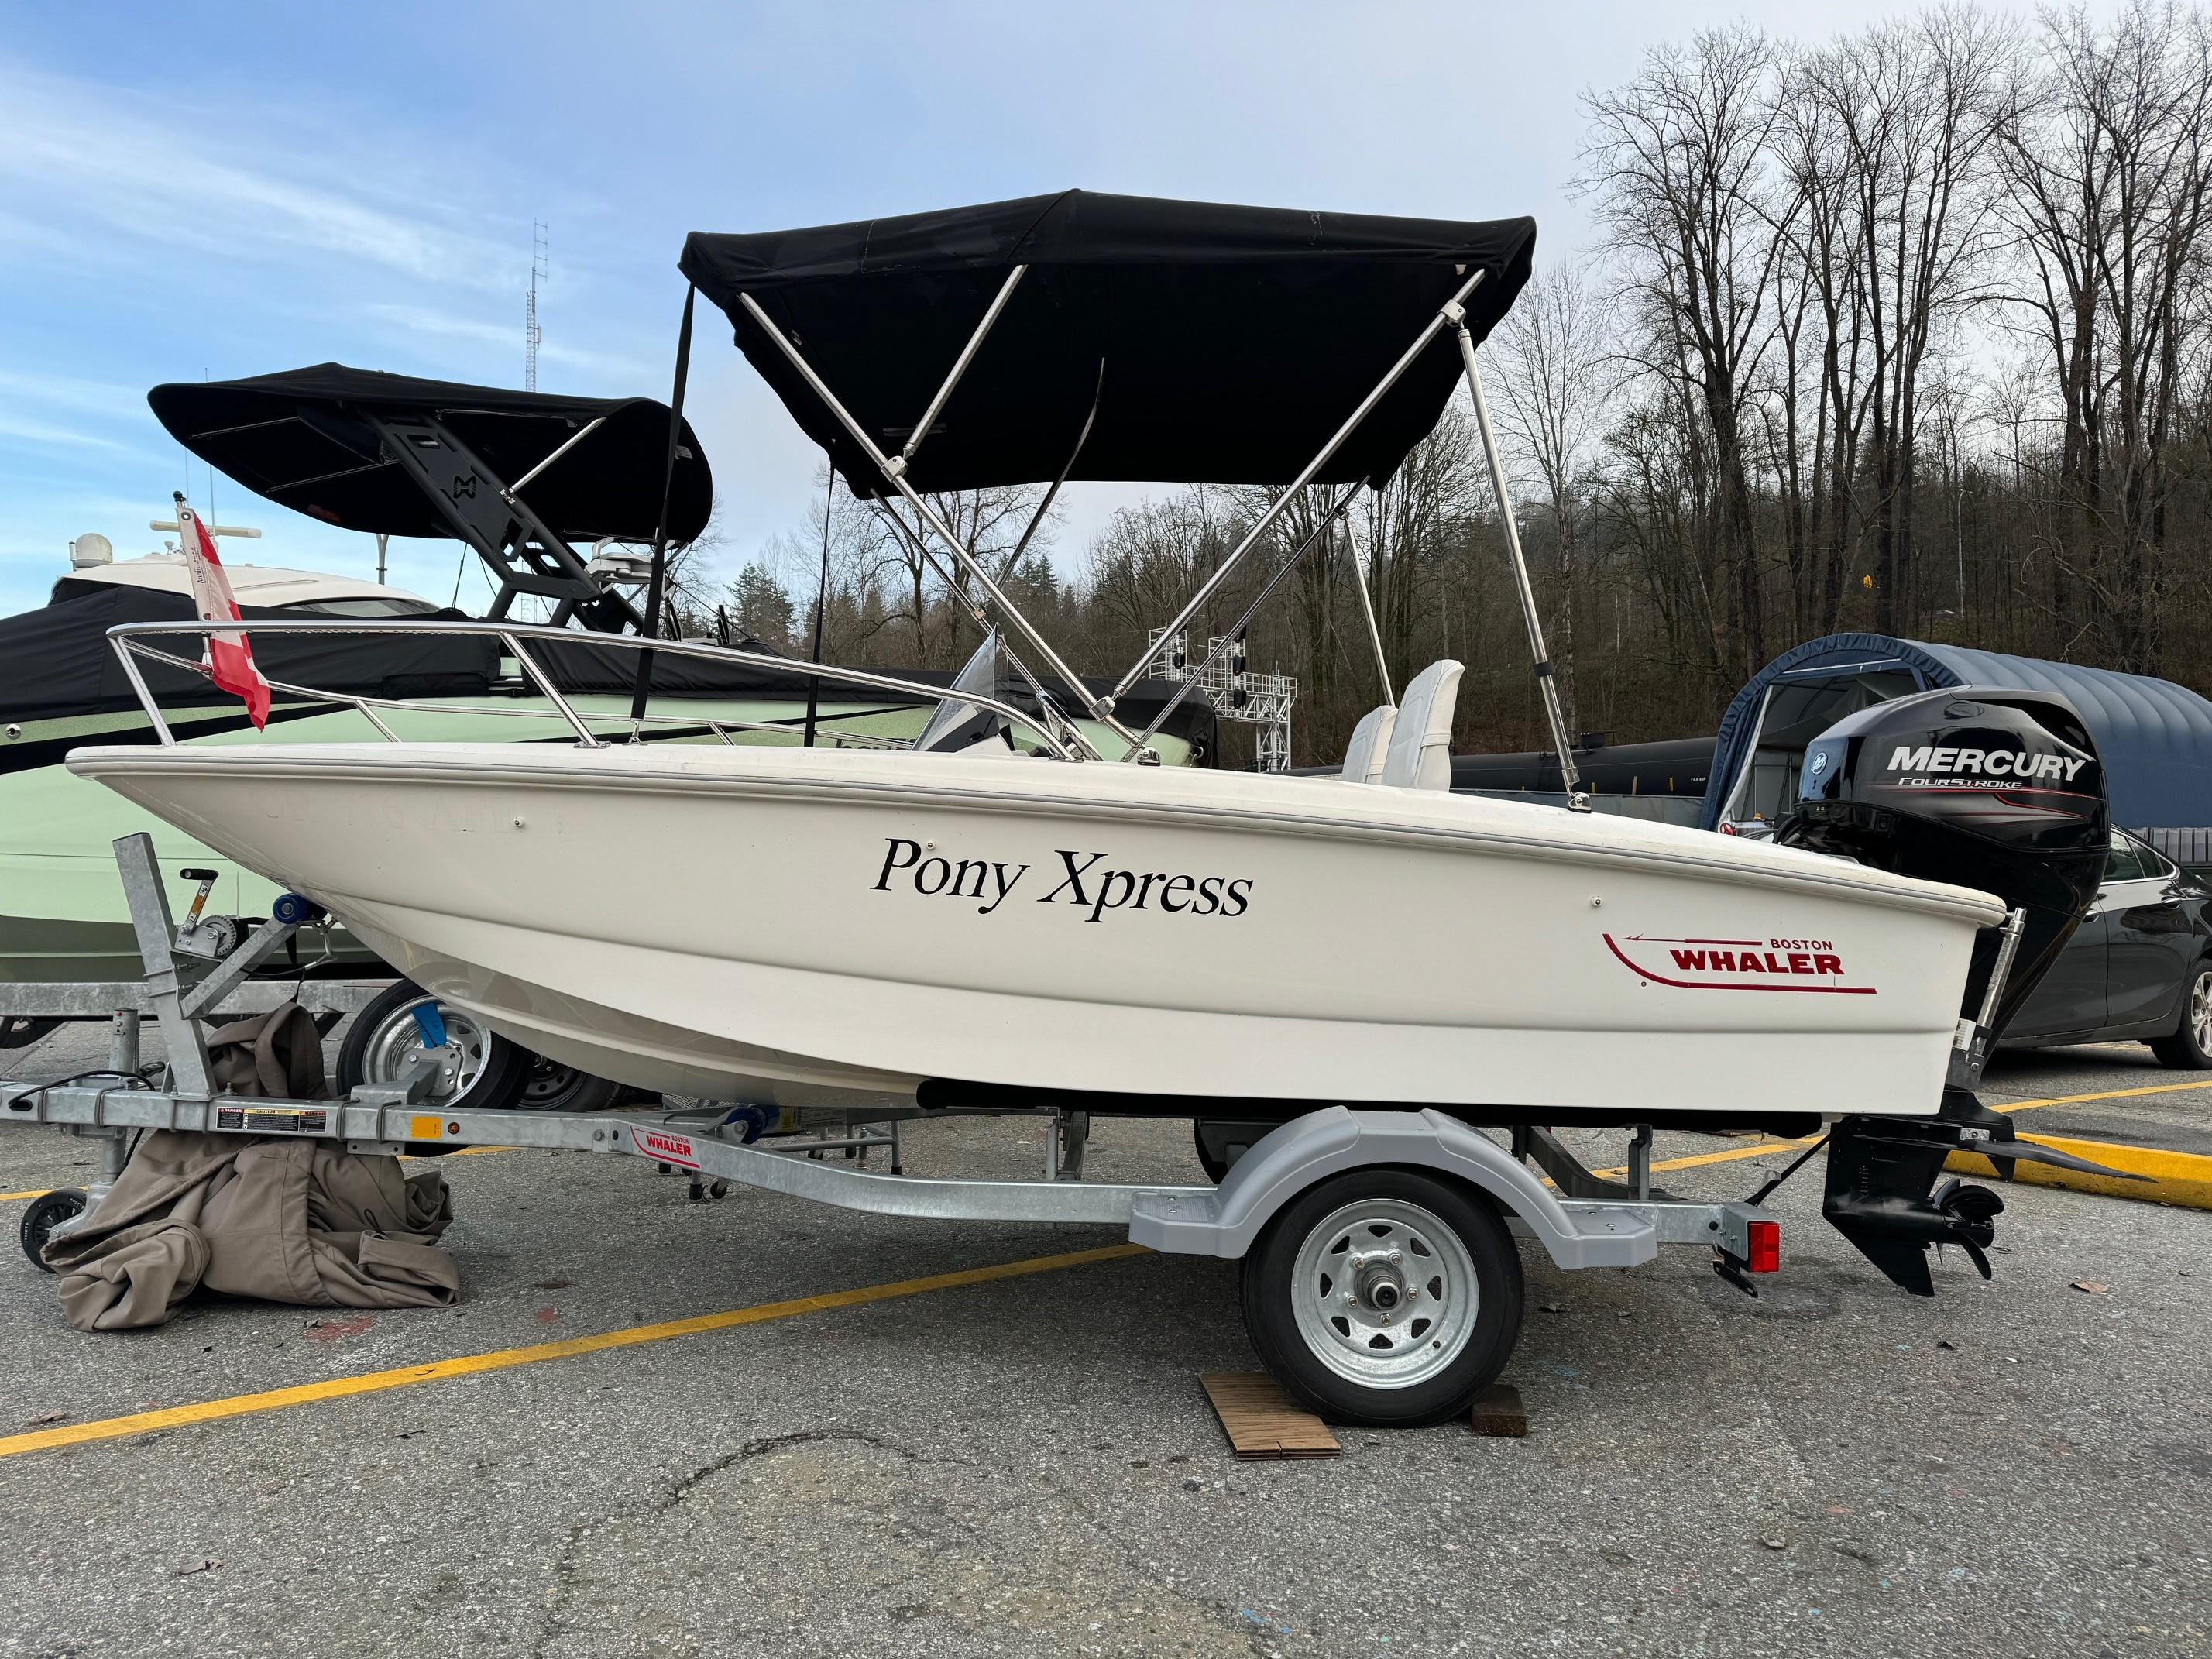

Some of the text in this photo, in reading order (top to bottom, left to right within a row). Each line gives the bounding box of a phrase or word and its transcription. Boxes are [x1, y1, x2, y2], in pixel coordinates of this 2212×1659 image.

[1887, 746, 2086, 781] MERCURY
[869, 837, 1254, 923] Pony Xpress
[1770, 939, 1833, 950] BOSTON
[1669, 949, 1846, 975] WHALER
[646, 1135, 692, 1156] WHALER
[672, 1135, 689, 1144] BOSTON
